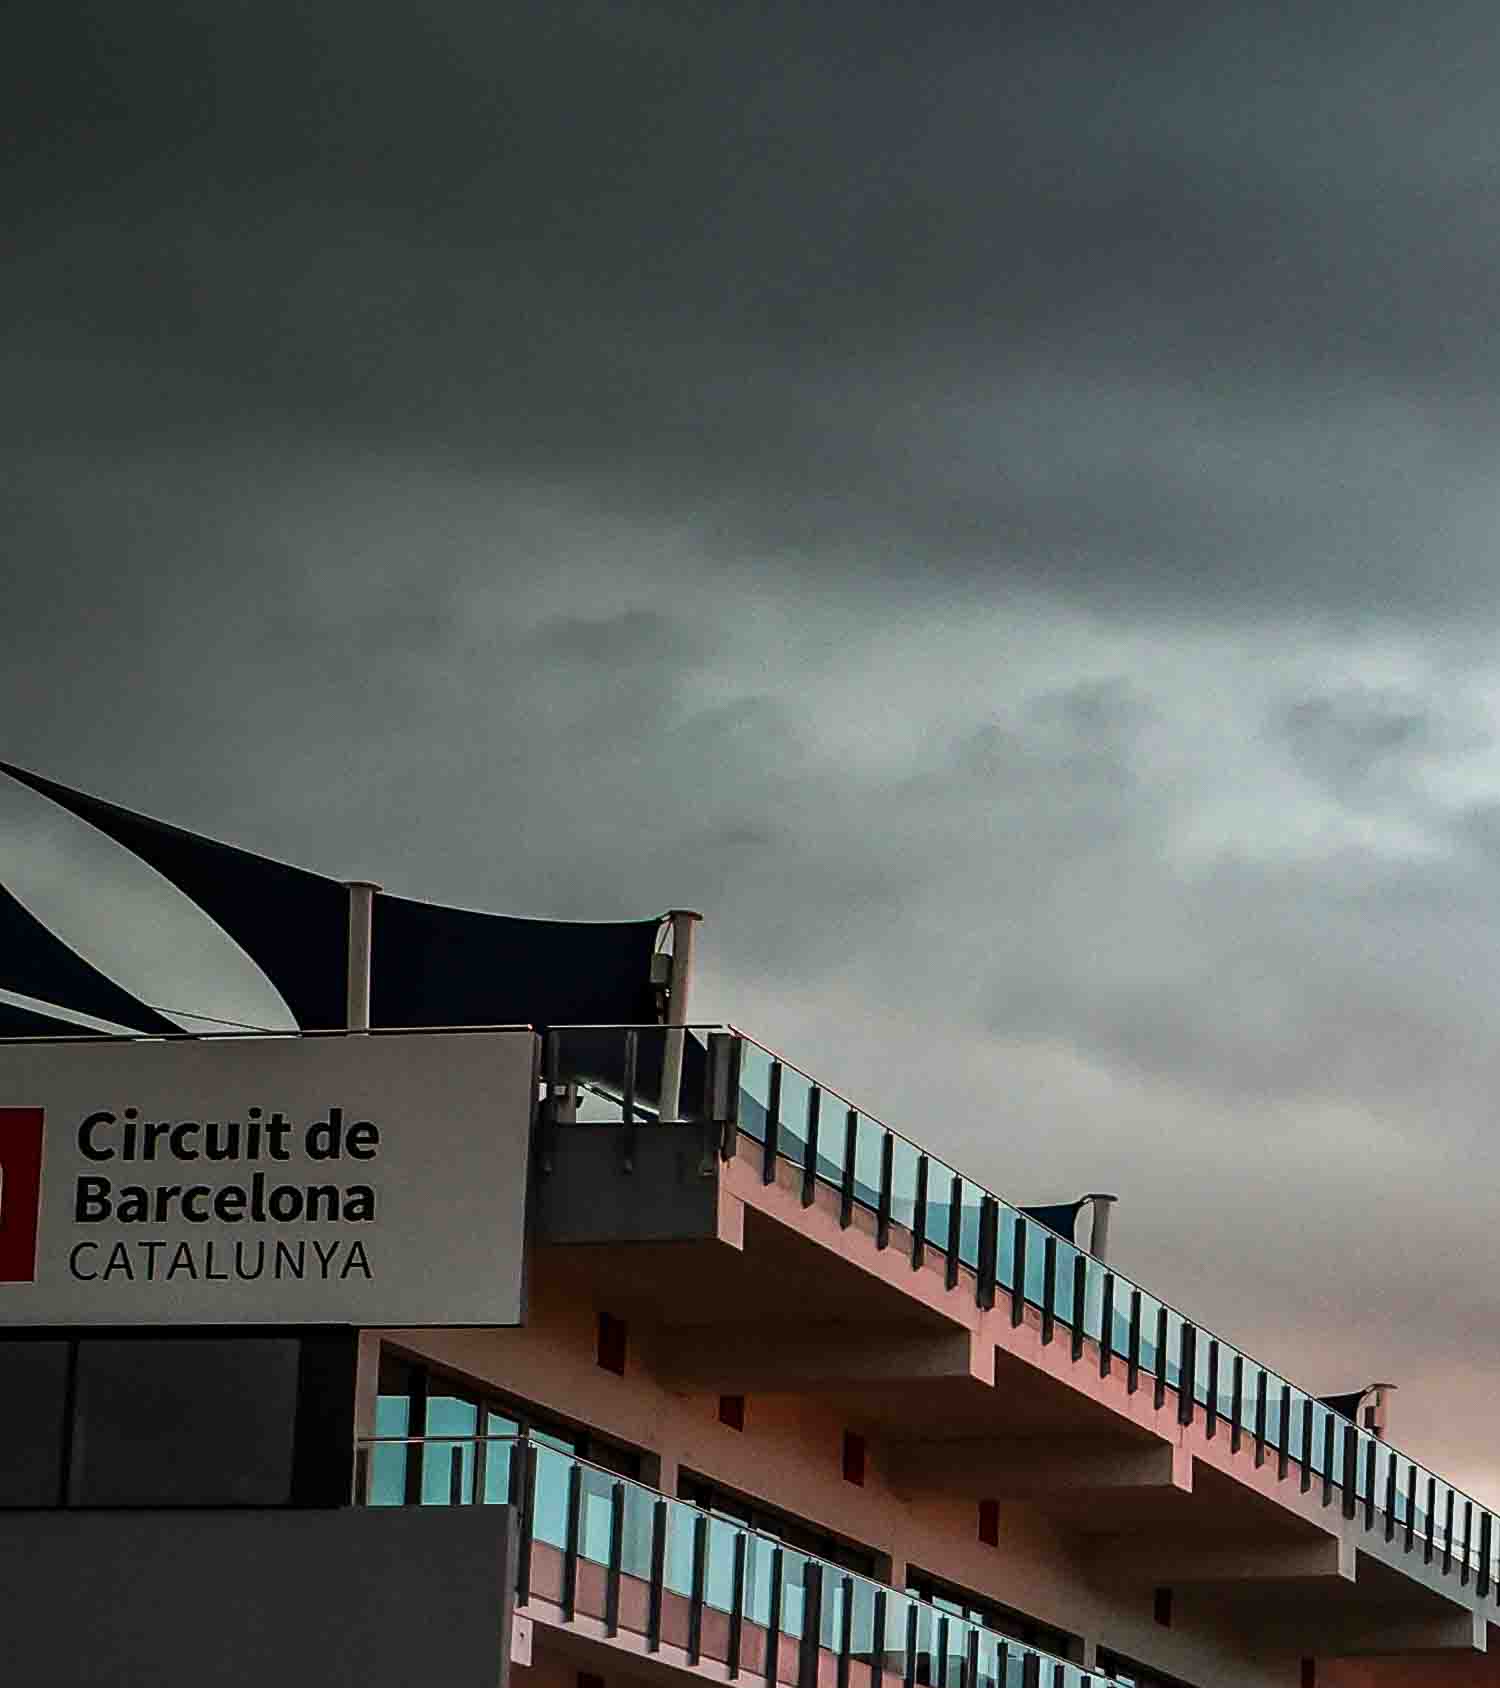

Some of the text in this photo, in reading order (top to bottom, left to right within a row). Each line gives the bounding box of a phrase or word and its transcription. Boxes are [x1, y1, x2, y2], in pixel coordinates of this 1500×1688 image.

[77, 1106, 381, 1161] Circuit de
[74, 1170, 376, 1223] Barcelona
[68, 1241, 374, 1280] CATALUNYA
